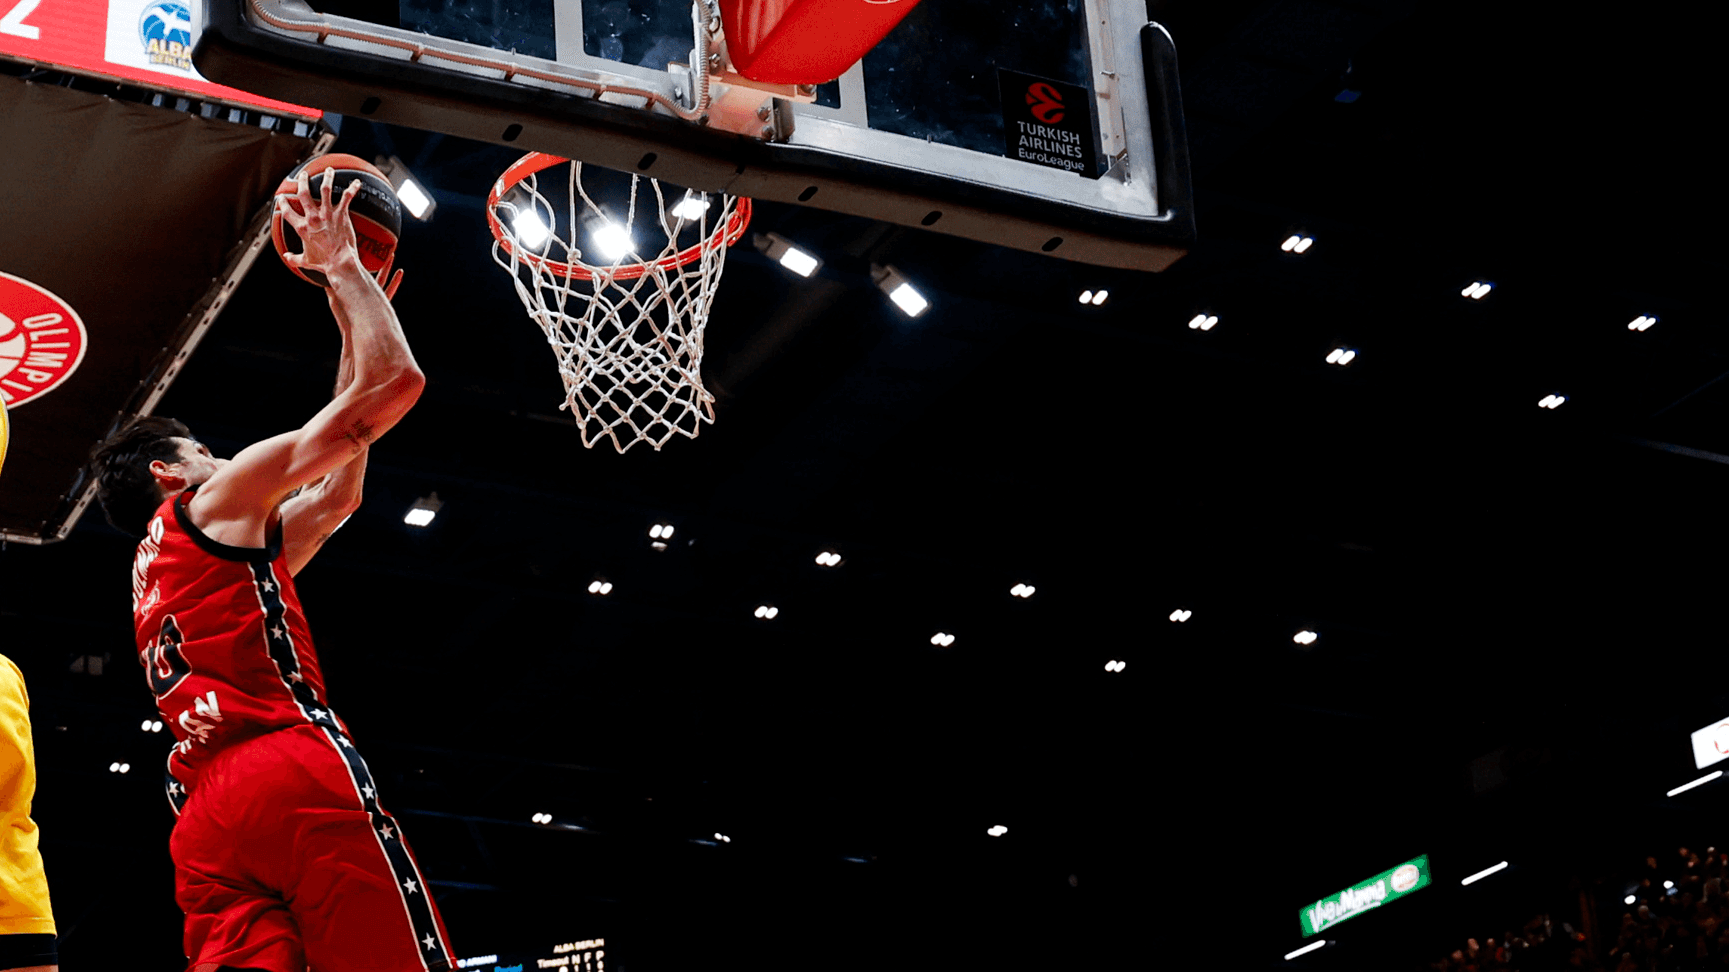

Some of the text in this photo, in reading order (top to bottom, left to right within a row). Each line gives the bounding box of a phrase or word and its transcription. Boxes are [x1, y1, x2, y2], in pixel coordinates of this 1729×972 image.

[146, 37, 191, 58] ALBA
[1017, 120, 1080, 145] TURKISH
[1018, 135, 1083, 159] AIRLINES
[1018, 148, 1085, 172] EuroLeague
